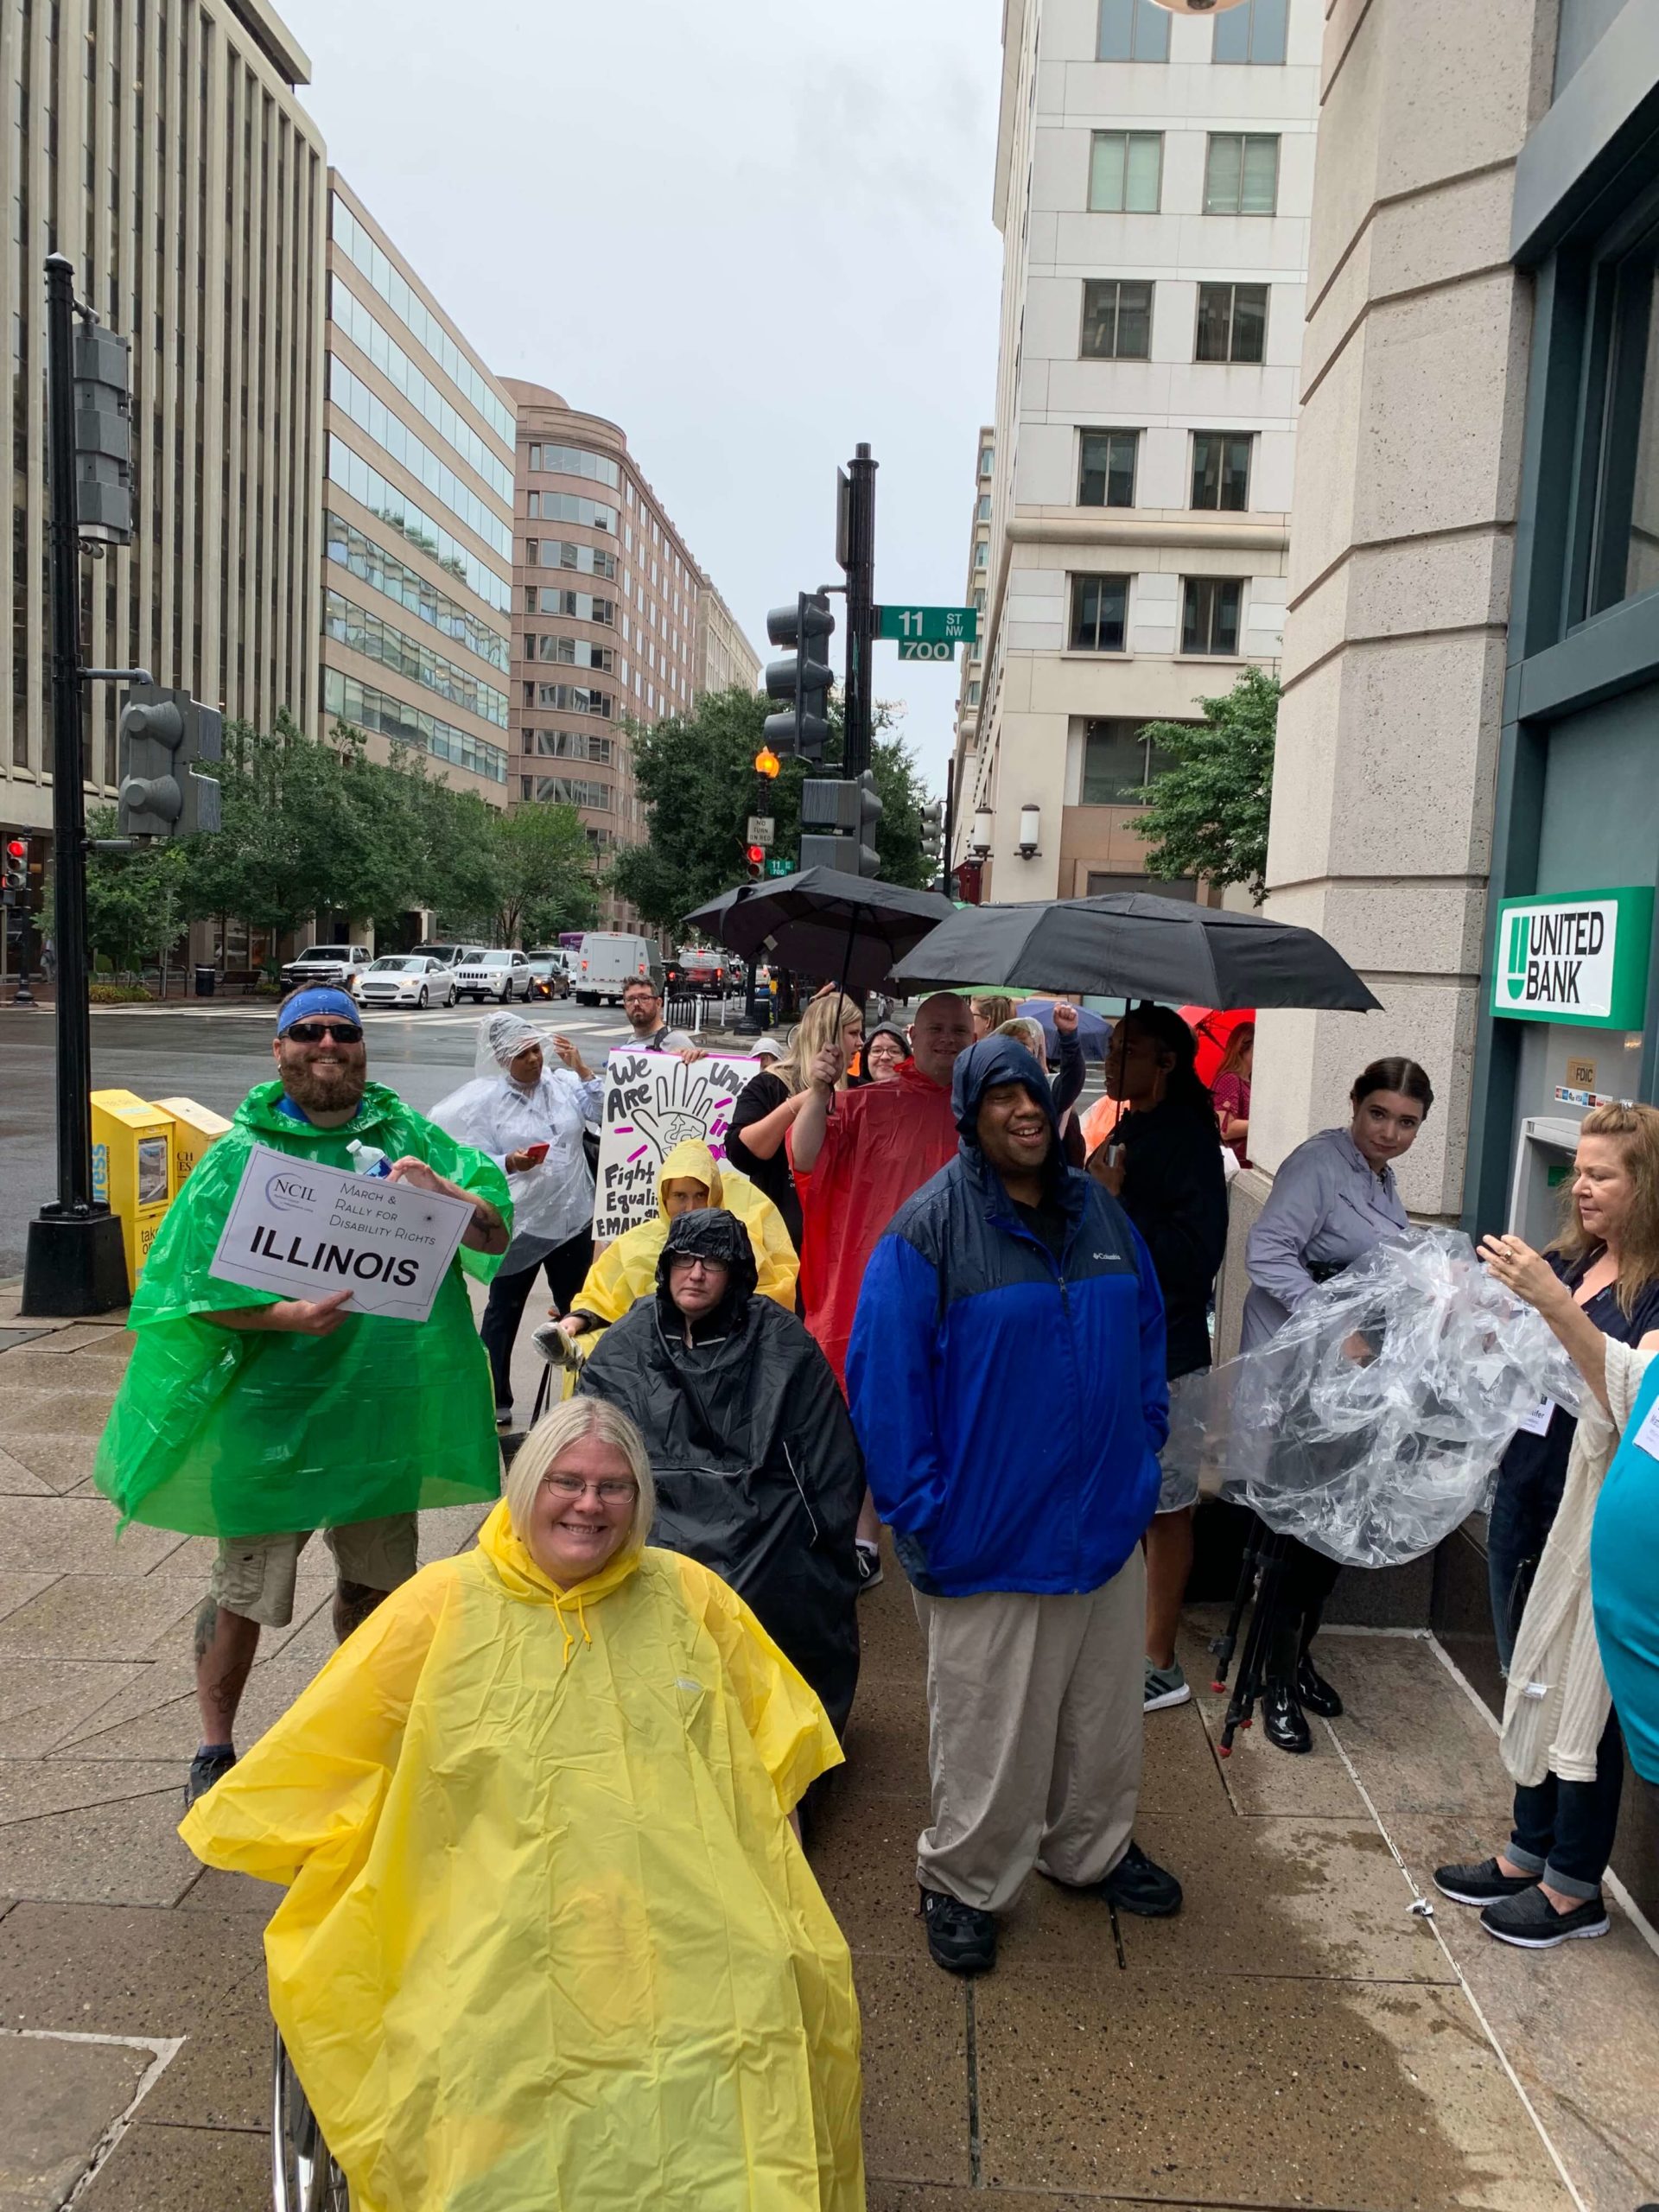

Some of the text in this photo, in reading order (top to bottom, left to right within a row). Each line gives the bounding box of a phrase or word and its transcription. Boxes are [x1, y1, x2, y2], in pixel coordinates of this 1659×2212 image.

[899, 611, 963, 636] 11 ST
[945, 626, 963, 637] NW
[903, 641, 950, 660] 700
[772, 861, 780, 869] 11
[1530, 911, 1605, 957] UNITED
[1526, 961, 1583, 1003] BANK
[608, 1055, 747, 1096] We Uni
[1575, 1067, 1593, 1083] FDIC
[177, 1151, 193, 1161] CH
[92, 1143, 107, 1202] ress
[176, 1161, 192, 1172] ES
[605, 1160, 654, 1190] Fight
[274, 1179, 317, 1202] NCIL
[387, 1196, 397, 1205] &
[607, 1189, 658, 1214] Equali
[645, 1209, 659, 1218] an
[142, 1226, 159, 1243] tak
[595, 1217, 650, 1237] EMAN
[250, 1225, 420, 1287] ILLINOIS
